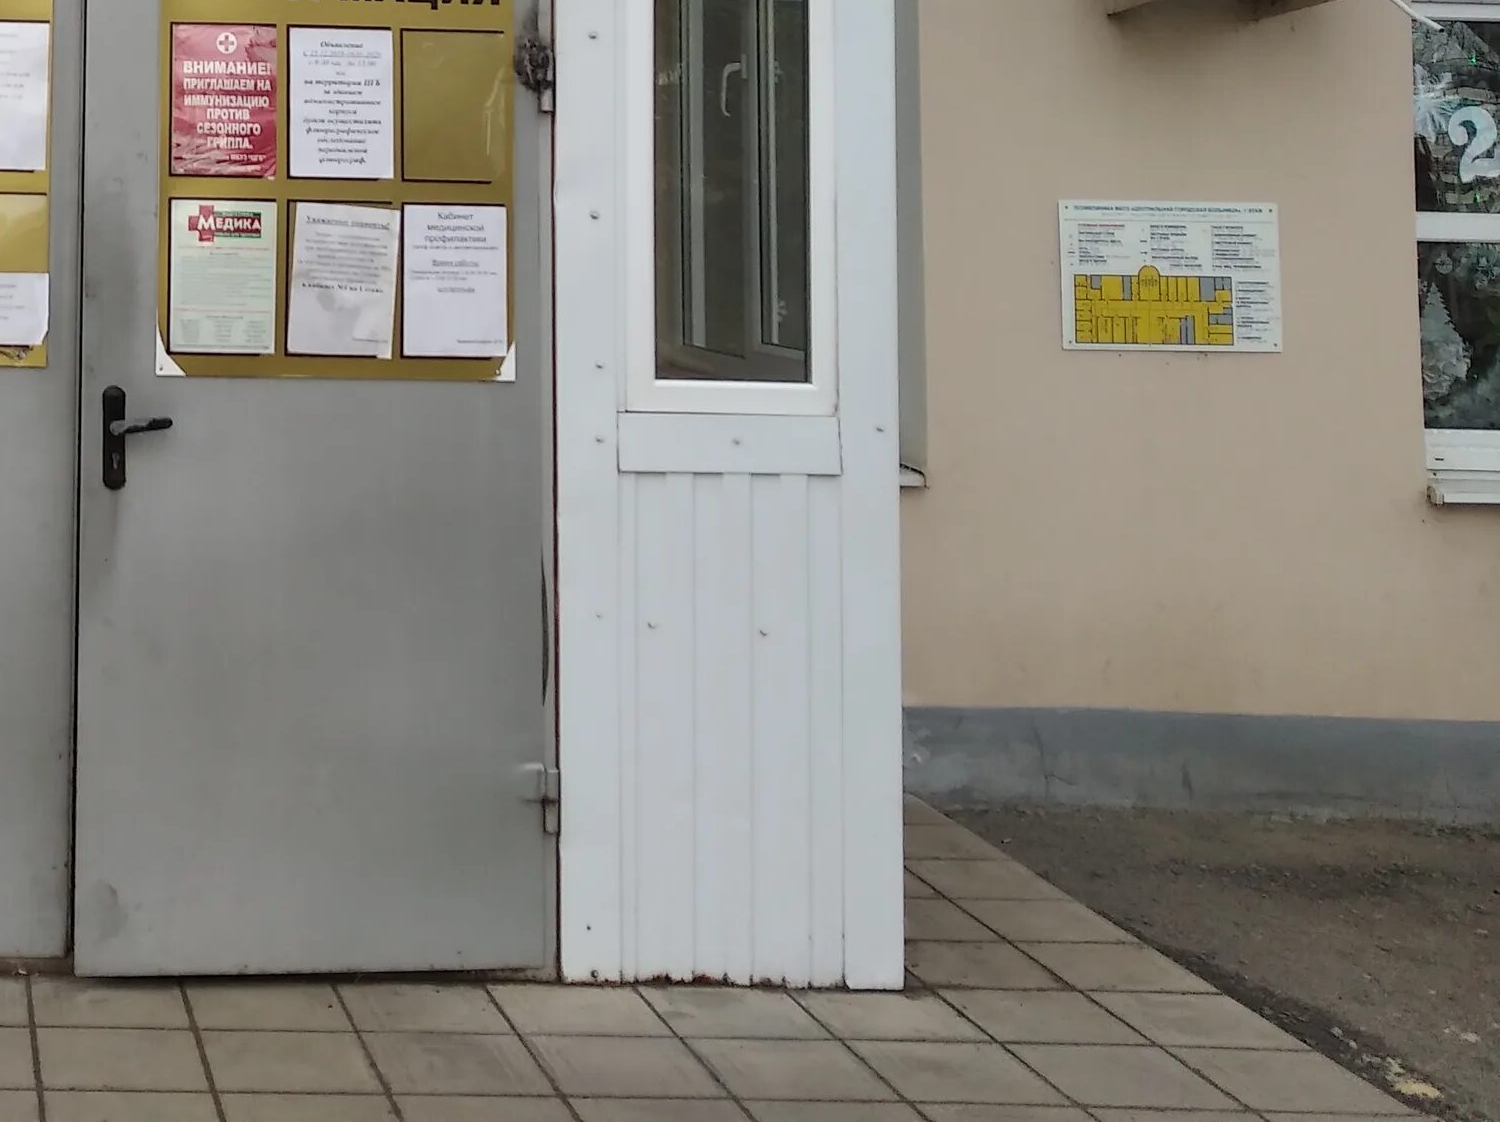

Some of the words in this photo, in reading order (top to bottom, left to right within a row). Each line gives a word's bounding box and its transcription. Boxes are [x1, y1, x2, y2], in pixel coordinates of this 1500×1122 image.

[183, 61, 271, 75] ВНИМАНИЕ!
[183, 78, 255, 91] ПРИГЛАШАЕМ
[257, 79, 272, 91] НА
[184, 95, 270, 108] ИММУНИЗАЦИЮ
[206, 108, 250, 120] ПРОТИВ
[196, 122, 261, 135] СЕЗОННОГО
[1448, 105, 1500, 183] 2
